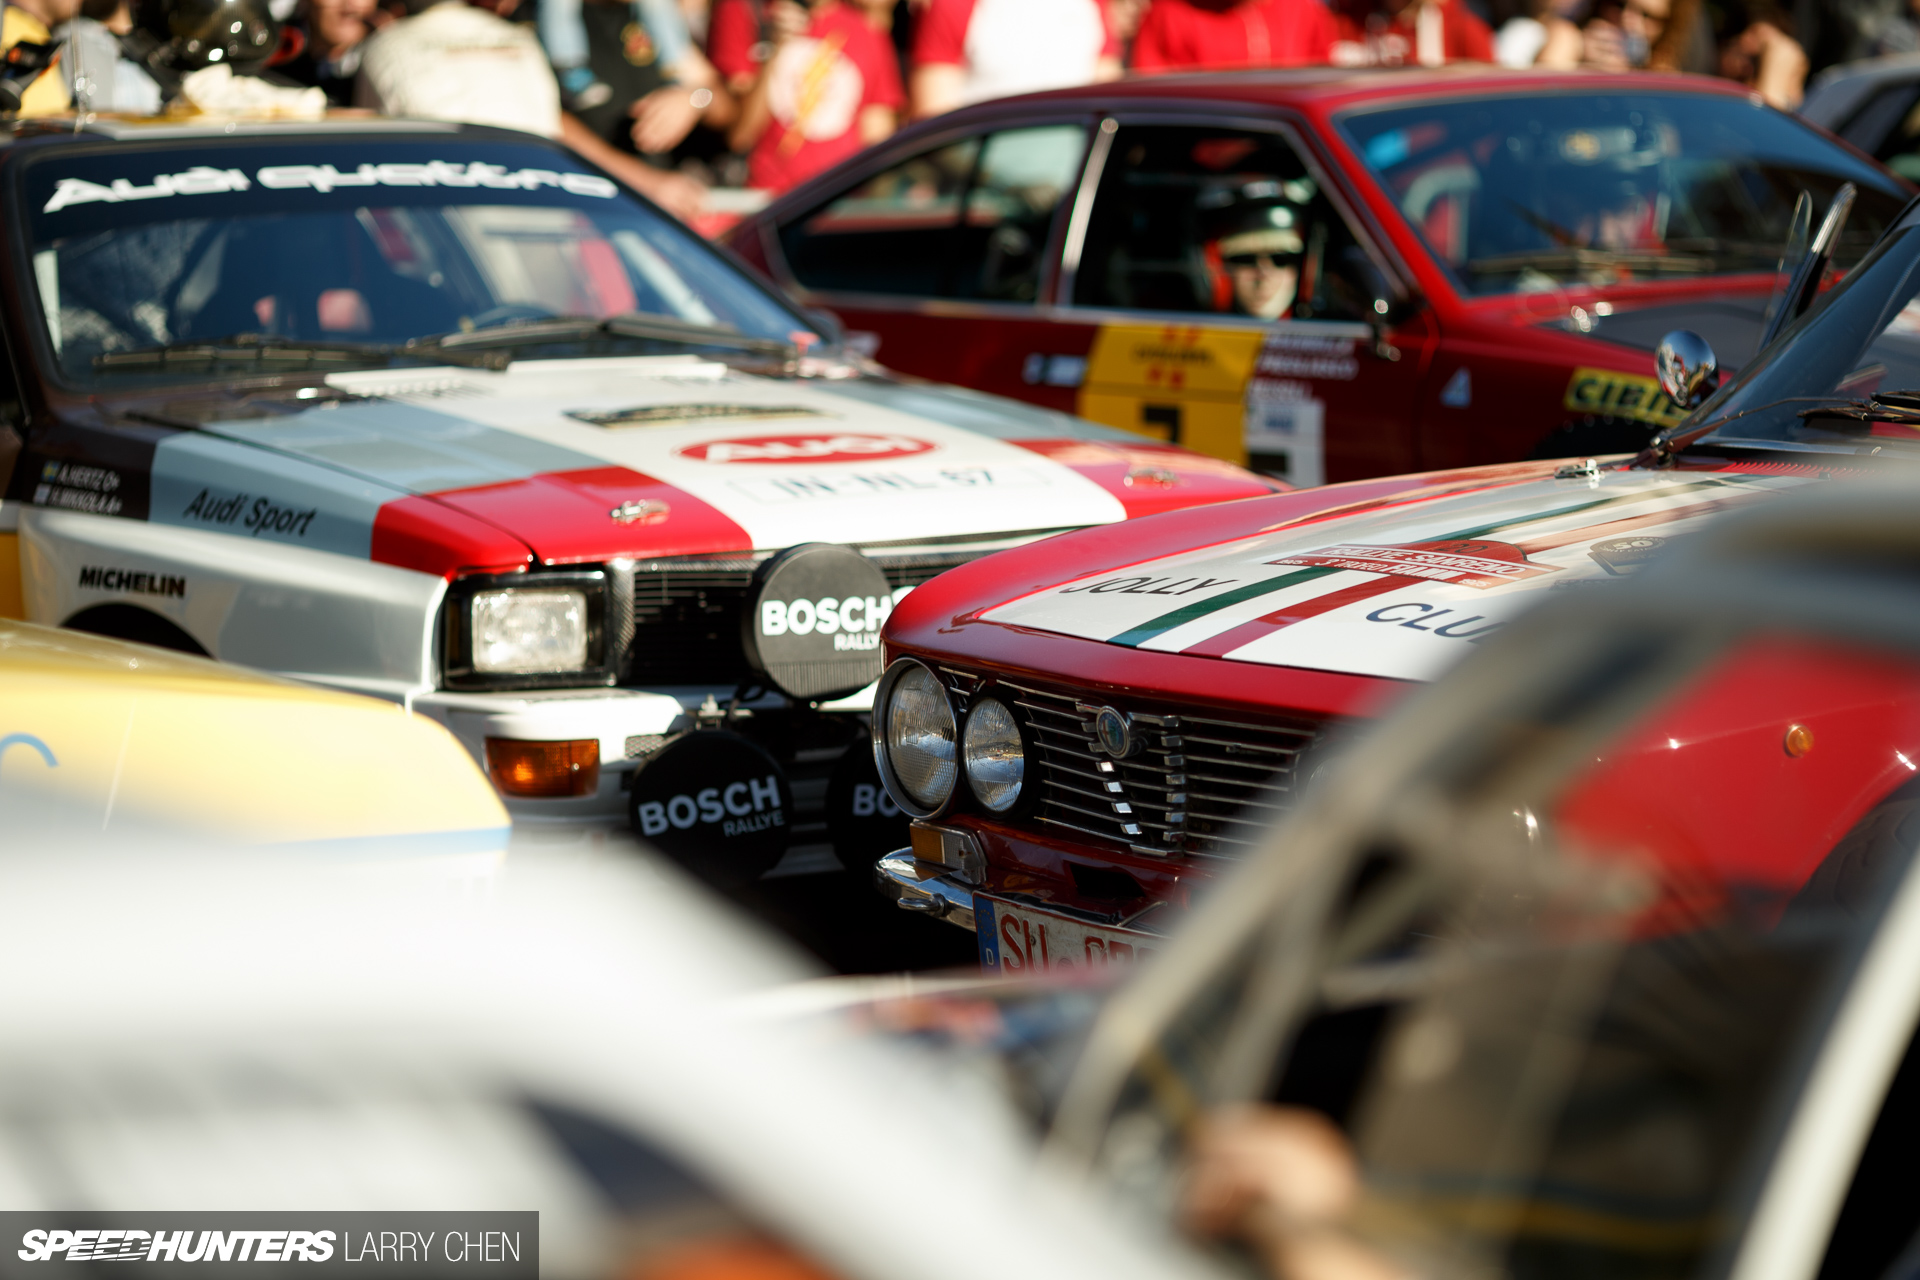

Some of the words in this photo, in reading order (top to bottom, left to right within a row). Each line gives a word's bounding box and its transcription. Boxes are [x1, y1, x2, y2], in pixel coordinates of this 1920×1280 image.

[183, 488, 248, 524] Audi
[244, 496, 317, 536] Sport
[1435, 543, 1488, 554] 20
[1613, 539, 1653, 550] 50
[1321, 548, 1414, 559] RALLYE
[1405, 555, 1526, 574] SANREMO
[79, 565, 186, 598] MICHELIN
[1058, 577, 1239, 595] JOLLY
[761, 595, 892, 636] BOSCH
[1366, 603, 1510, 644] CLU
[638, 775, 781, 837] BOSCH
[723, 809, 785, 837] RALLYE
